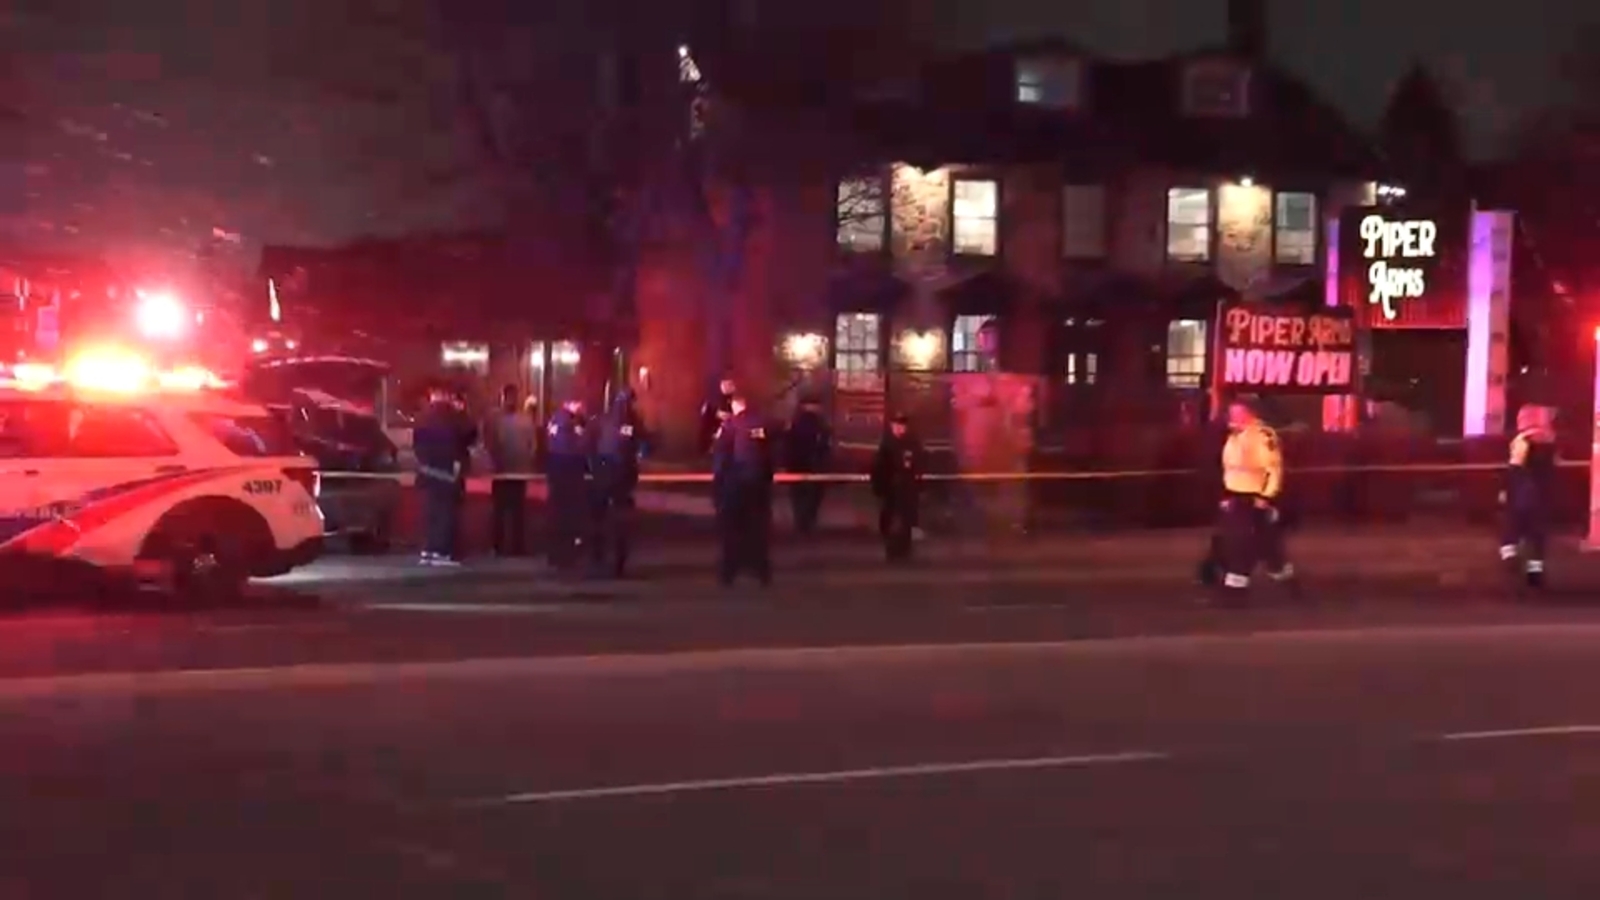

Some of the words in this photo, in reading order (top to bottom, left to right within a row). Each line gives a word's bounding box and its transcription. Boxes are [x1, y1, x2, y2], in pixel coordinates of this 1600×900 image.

[1361, 215, 1436, 257] PIPER
[1369, 261, 1424, 320] ARMS
[1226, 308, 1305, 345] PIPER
[1225, 349, 1295, 384] NOW
[1297, 351, 1351, 385] OPEN
